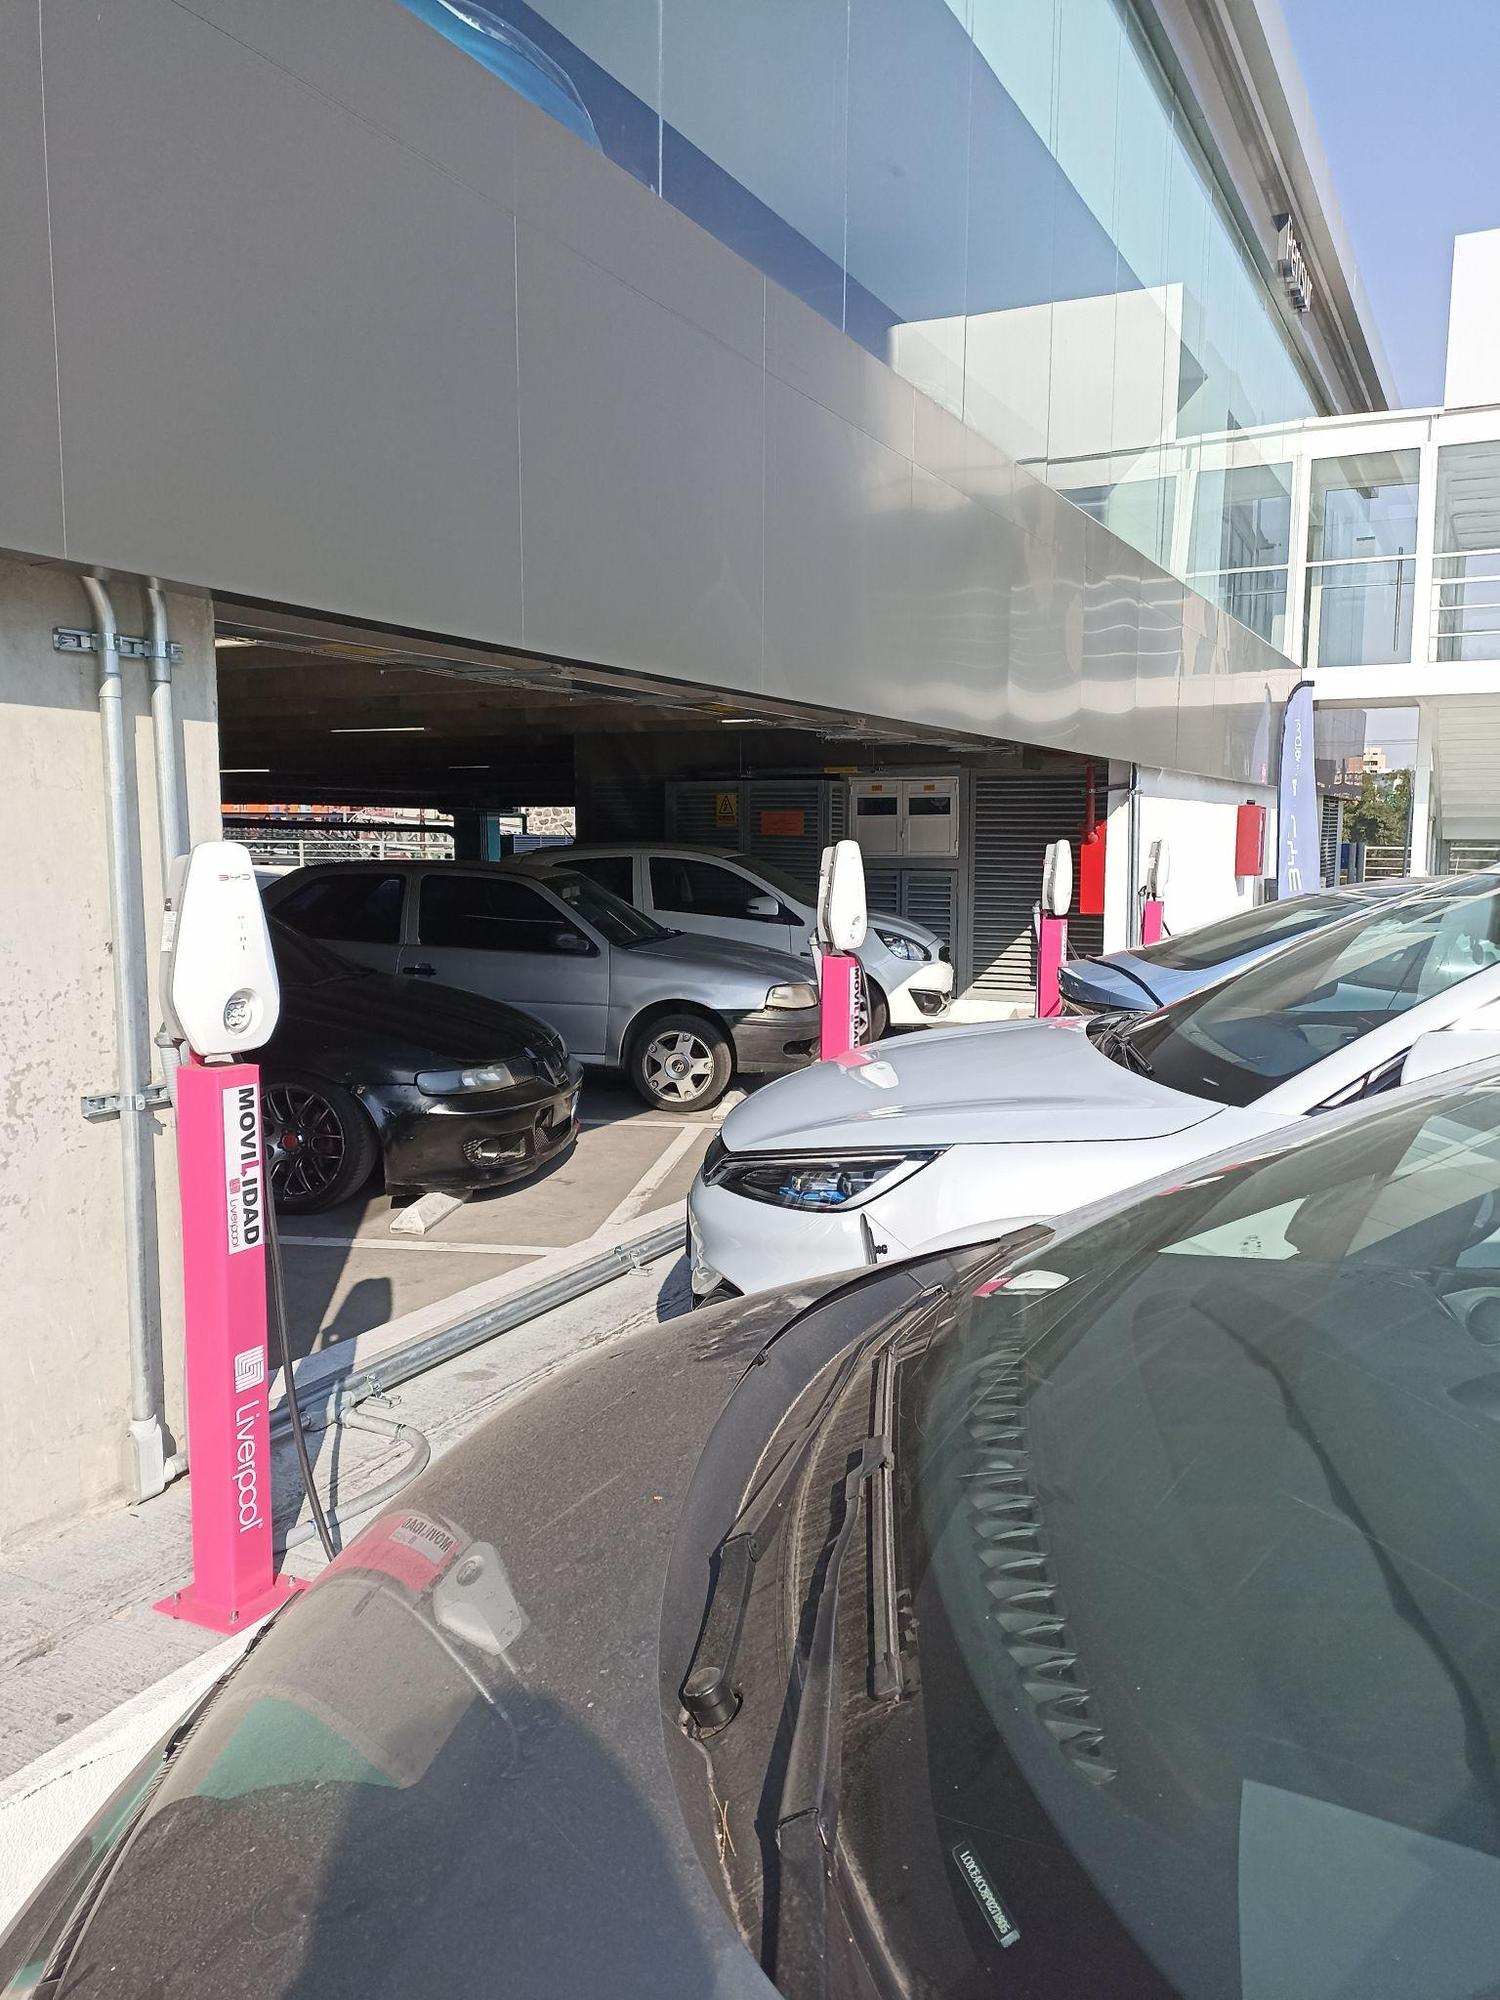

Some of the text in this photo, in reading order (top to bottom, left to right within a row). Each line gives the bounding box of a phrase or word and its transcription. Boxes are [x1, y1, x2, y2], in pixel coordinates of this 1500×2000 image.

[229, 1198, 240, 1248] Liverpool
[238, 1087, 260, 1245] MOVILIDAD
[231, 1399, 263, 1534] Liverpool
